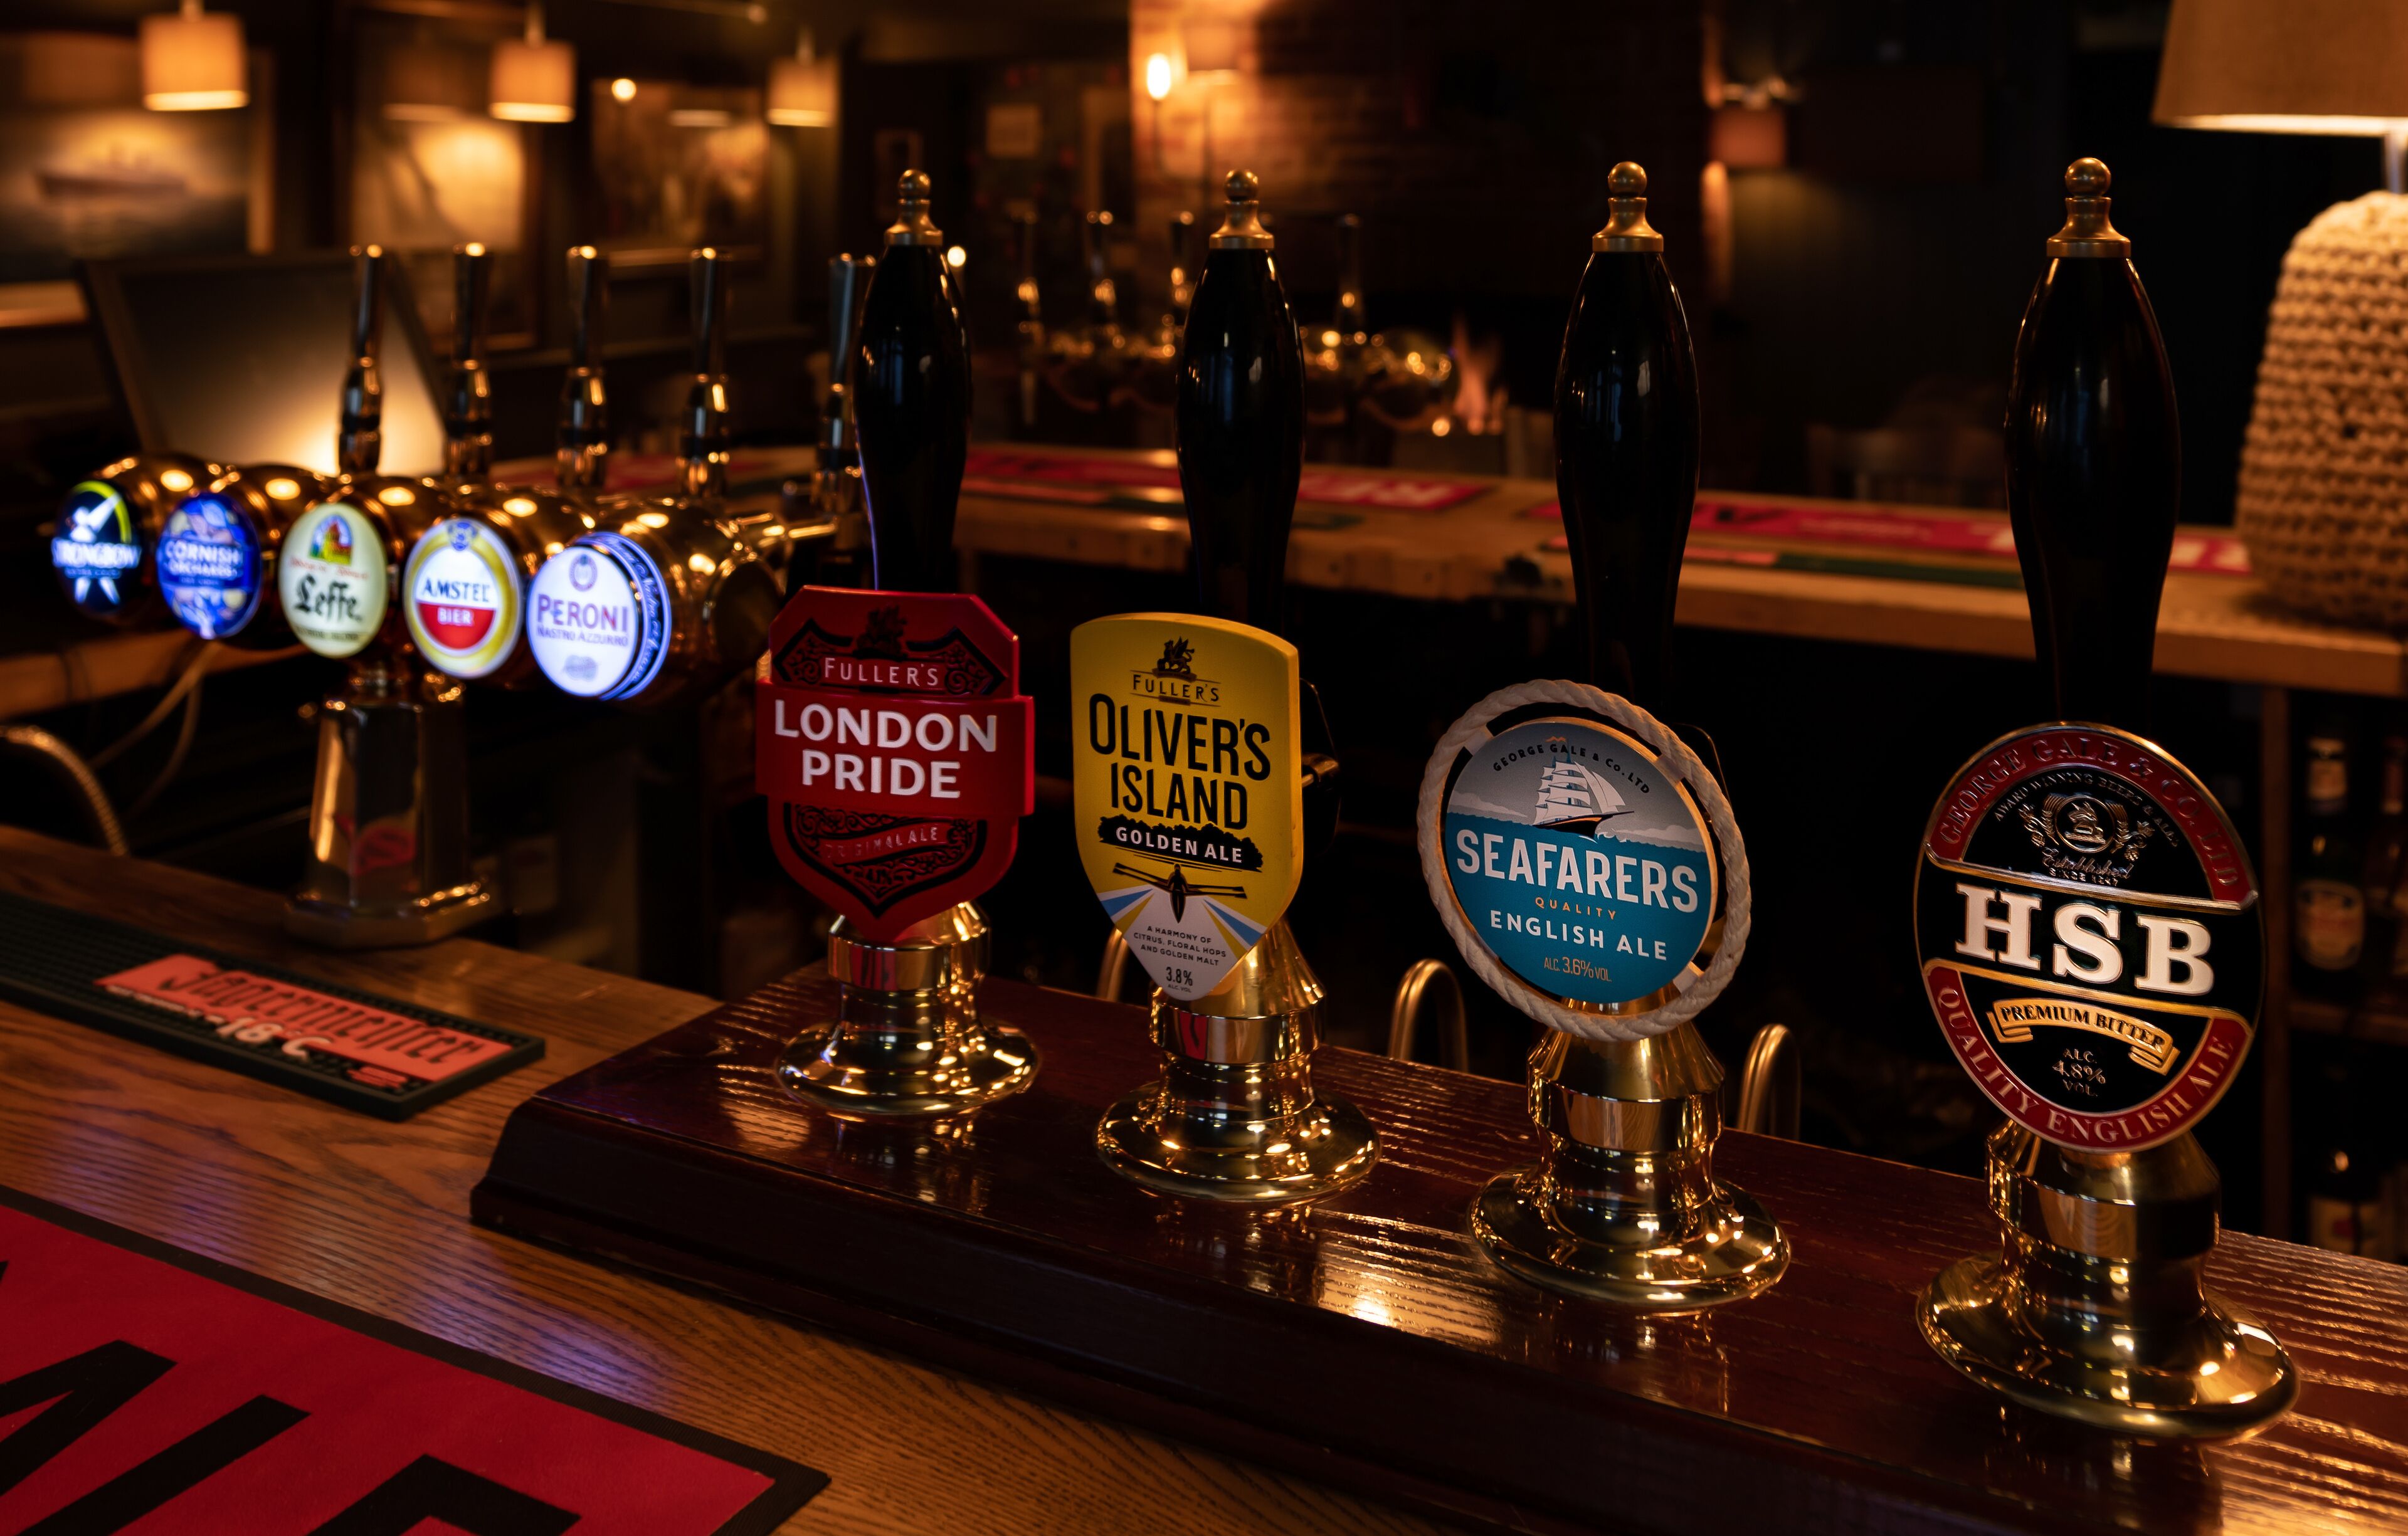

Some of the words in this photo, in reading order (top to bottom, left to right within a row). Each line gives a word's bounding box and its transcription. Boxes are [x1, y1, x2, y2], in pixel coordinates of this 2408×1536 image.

[165, 540, 243, 564] CORNISH
[294, 573, 362, 621] Leffe
[422, 577, 490, 603] AMSTEL
[437, 608, 473, 626] BIER
[537, 594, 630, 633] PERONI
[537, 626, 575, 641] NASTRO
[578, 628, 628, 646] AZZURRO
[824, 657, 939, 687] FULLER'S
[1133, 674, 1220, 702] FULLER'S
[774, 699, 997, 752] LONDON
[1089, 693, 1271, 781] OLIVER'S
[802, 749, 961, 799] PRIDE
[1492, 744, 1545, 772] GEORGE
[1550, 744, 1587, 758] GALE
[1592, 752, 1600, 762] &
[1627, 772, 1650, 794] LTD
[1111, 762, 1248, 831] ISLAND
[1939, 747, 2027, 845] GEORGE
[2032, 737, 2121, 766] GALE
[2129, 756, 2154, 780] &
[2197, 831, 2240, 888] LTD
[825, 833, 903, 858] ORGINAL
[908, 826, 939, 844] ALE
[1116, 827, 1197, 856] GOLDEN
[1204, 844, 1243, 863] ALE
[1456, 829, 1699, 913] SEAFARERS
[1534, 897, 1617, 920] QUALITY
[1155, 927, 1198, 942] HARMONY
[1200, 936, 1212, 944] OF
[1168, 939, 1201, 952] FLORAL
[1203, 947, 1227, 957] HOPS
[1490, 910, 1604, 949] ENGLISH
[1616, 934, 1667, 961] ALE
[1955, 883, 2215, 996] HSB
[1141, 944, 1158, 953] AND
[1160, 948, 1194, 961] GOLDEN
[1196, 956, 1219, 966] MALT
[1562, 956, 1594, 979] 3.6%
[1166, 966, 1193, 987] 3.8%
[2000, 1004, 2090, 1025] PREMIUM
[2095, 1011, 2165, 1052] BITTER
[1938, 986, 2041, 1117] QUALITY
[2046, 1092, 2194, 1144] ENGLISH
[2187, 1034, 2234, 1097] ALE
[2062, 1048, 2097, 1064] ALC.
[2052, 1060, 2107, 1085] 4.8%
[2062, 1081, 2099, 1098] VOL.
